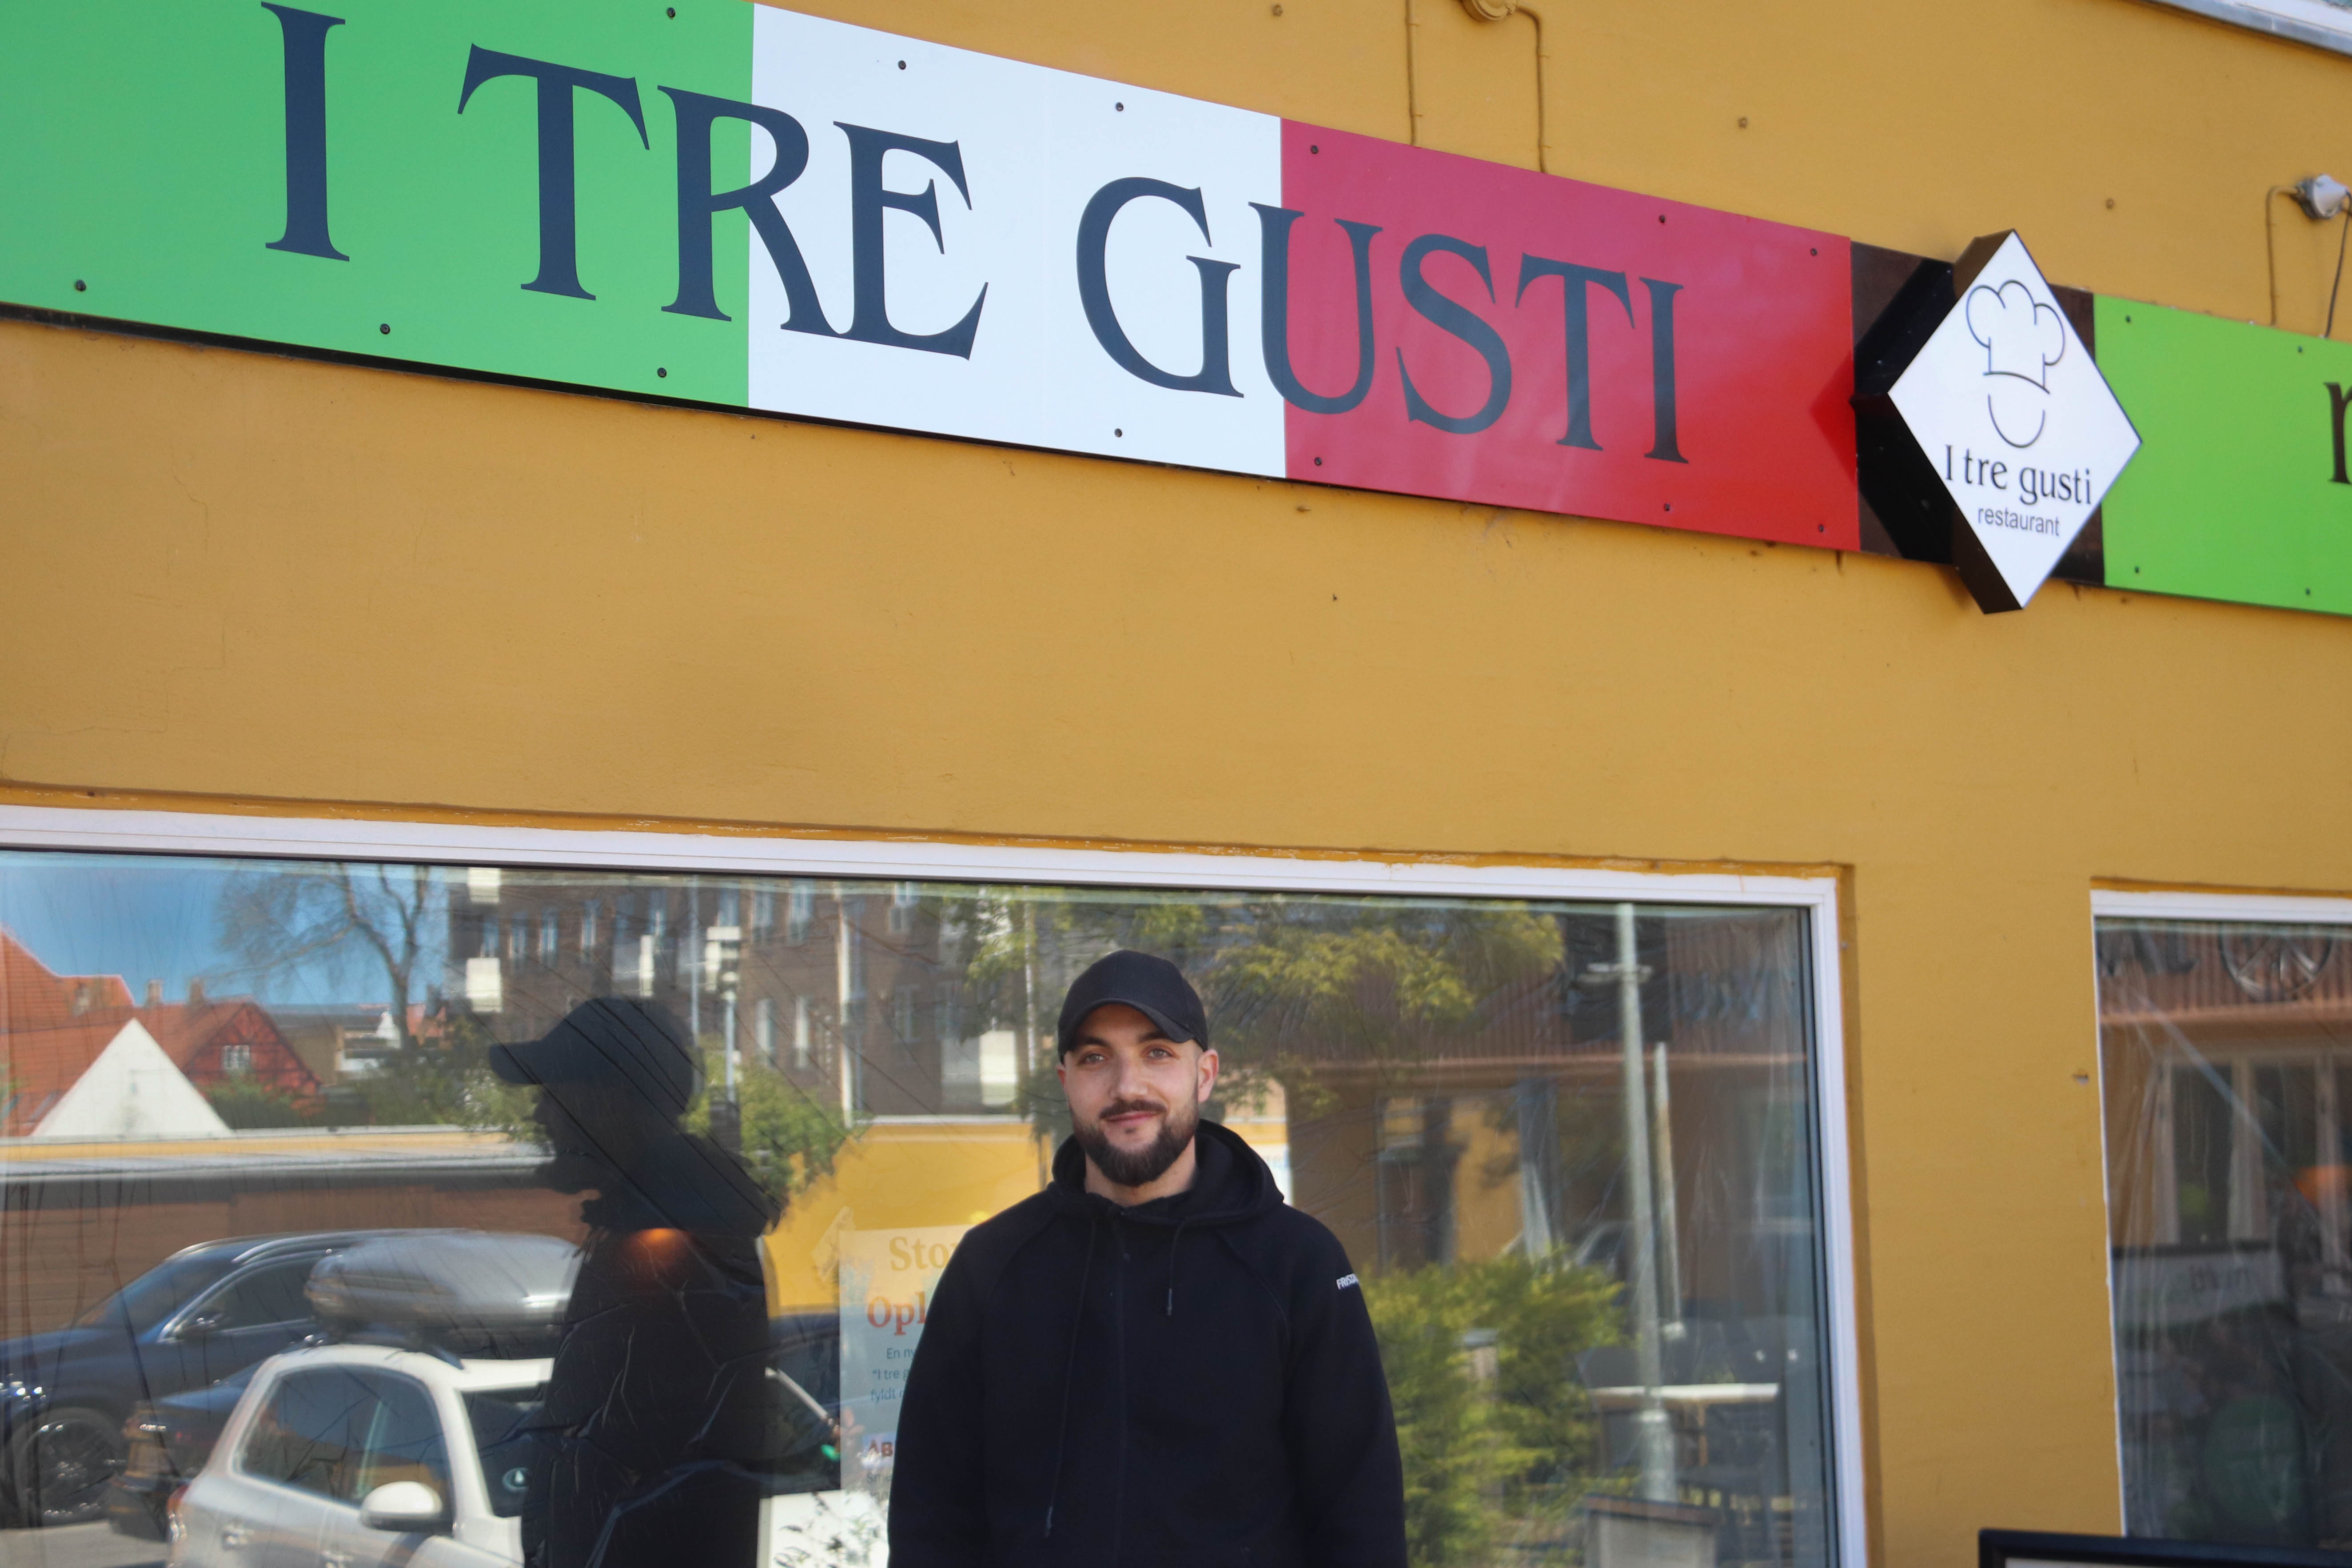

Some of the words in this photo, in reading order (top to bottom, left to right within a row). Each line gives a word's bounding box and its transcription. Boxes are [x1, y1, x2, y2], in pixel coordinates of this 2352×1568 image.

[260, 1, 350, 262] I
[457, 42, 989, 361] TRE
[1076, 176, 1689, 464] GUSTI
[1943, 444, 1953, 482] I
[1963, 448, 2008, 491] tre
[2018, 464, 2092, 506] gusti
[1977, 506, 2060, 536] restaurant
[887, 1348, 900, 1359] En
[884, 1369, 899, 1380] tre
